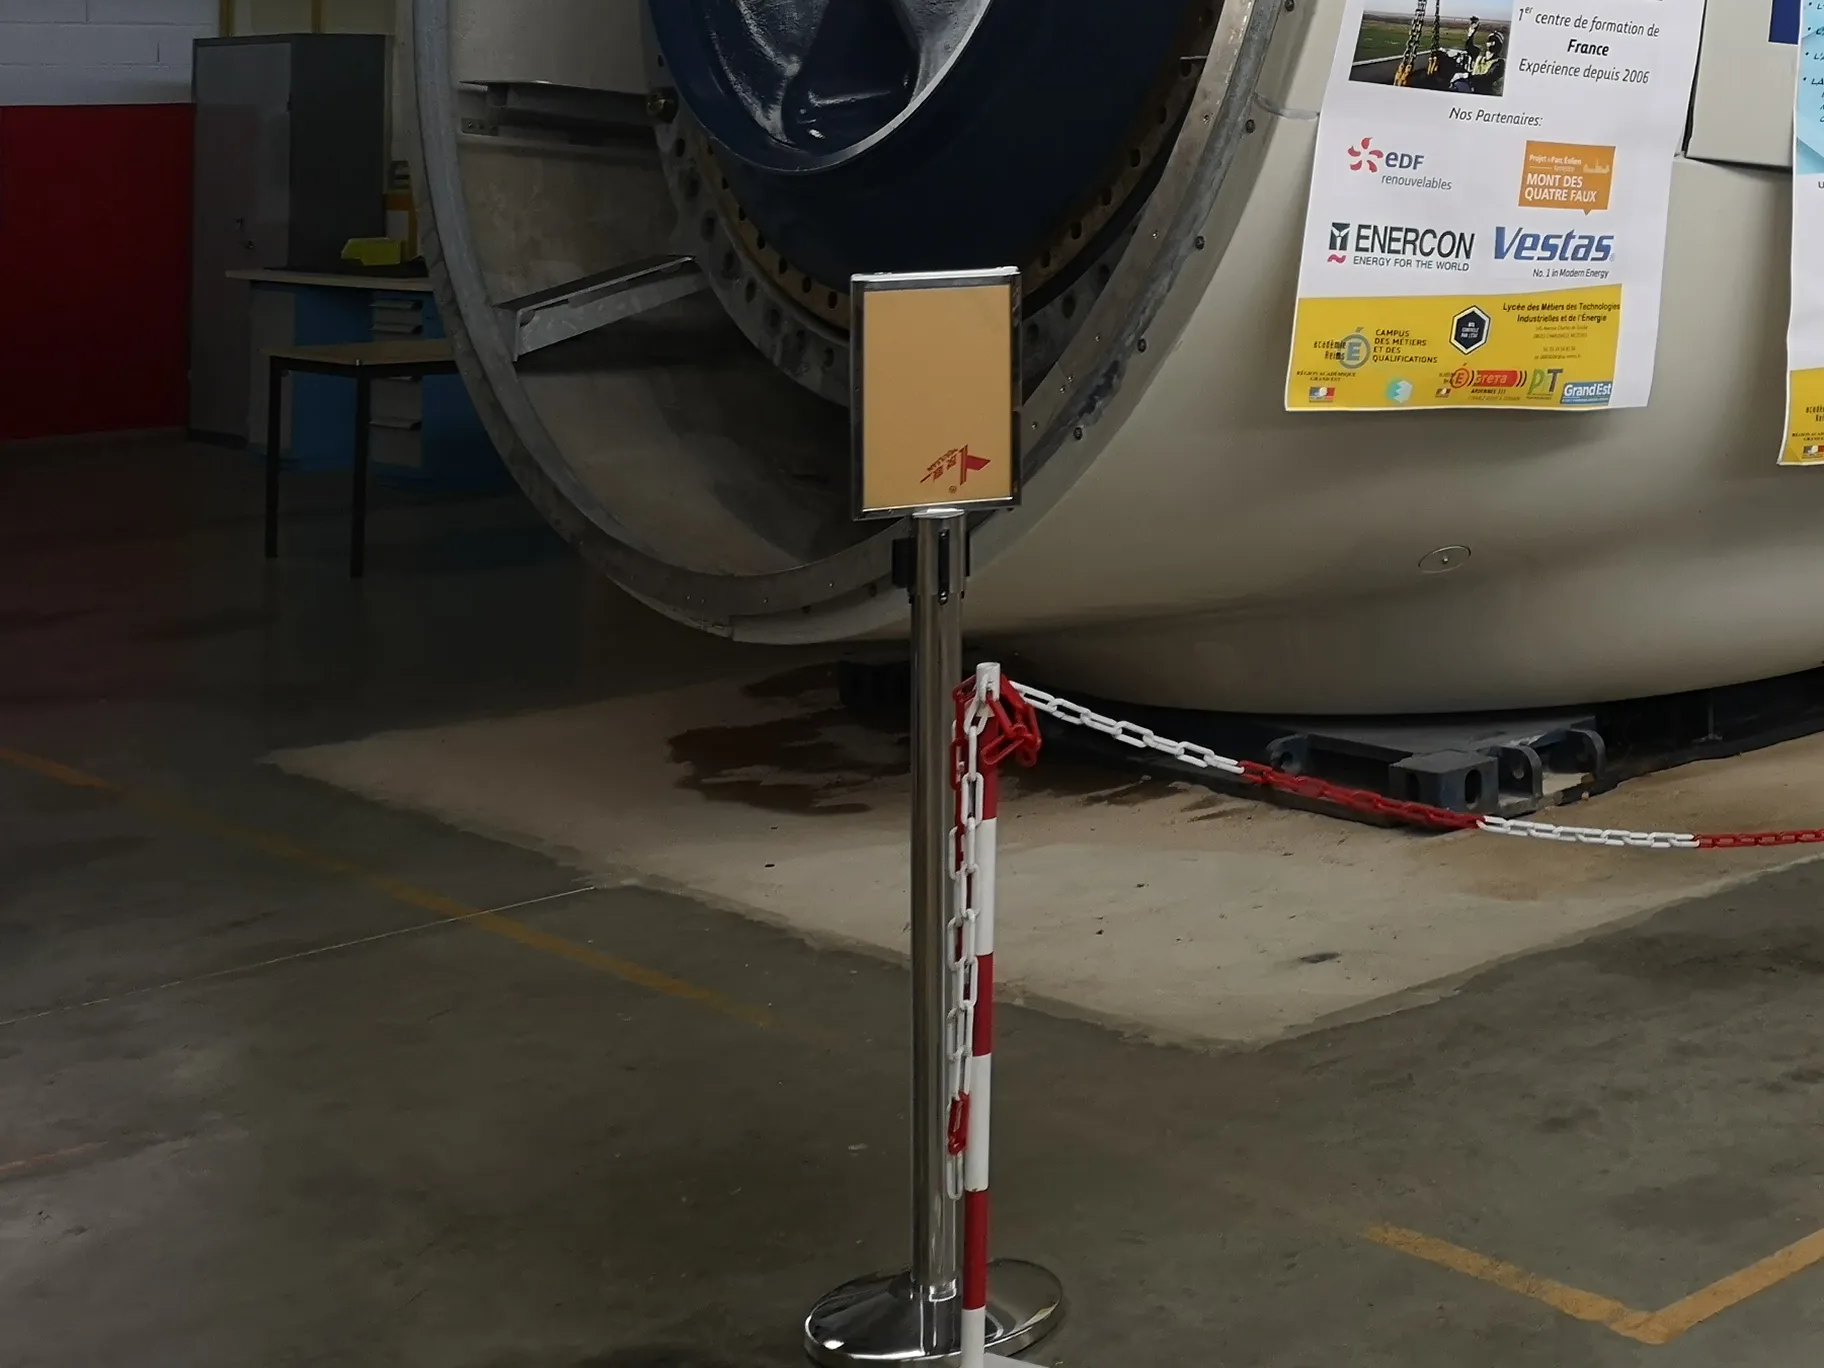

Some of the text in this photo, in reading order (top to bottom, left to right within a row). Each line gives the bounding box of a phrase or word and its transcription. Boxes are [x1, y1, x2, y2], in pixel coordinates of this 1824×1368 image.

[1517, 5, 1660, 37] 1er centre de formation de
[1568, 39, 1609, 57] France
[1519, 59, 1650, 84] Expérience depuis 2006
[1449, 107, 1543, 127] Nos Partenaires:
[1381, 174, 1452, 191] renouvelables
[1527, 173, 1583, 188] MONT DES
[1525, 188, 1597, 202] QUATRE FAUX
[1356, 225, 1476, 259] ENERCON
[1494, 226, 1615, 262] Vestas
[1353, 256, 1470, 272] ENERGY FOR THE WORLD
[1533, 268, 1609, 279] No. 1 in Modern Energy
[1503, 302, 1526, 313] Lycée
[1541, 303, 1564, 311] Métiers
[1579, 303, 1620, 311] Technologies
[1392, 338, 1427, 346] MÉTIERS
[1373, 355, 1438, 364] QUALIFICATIONS
